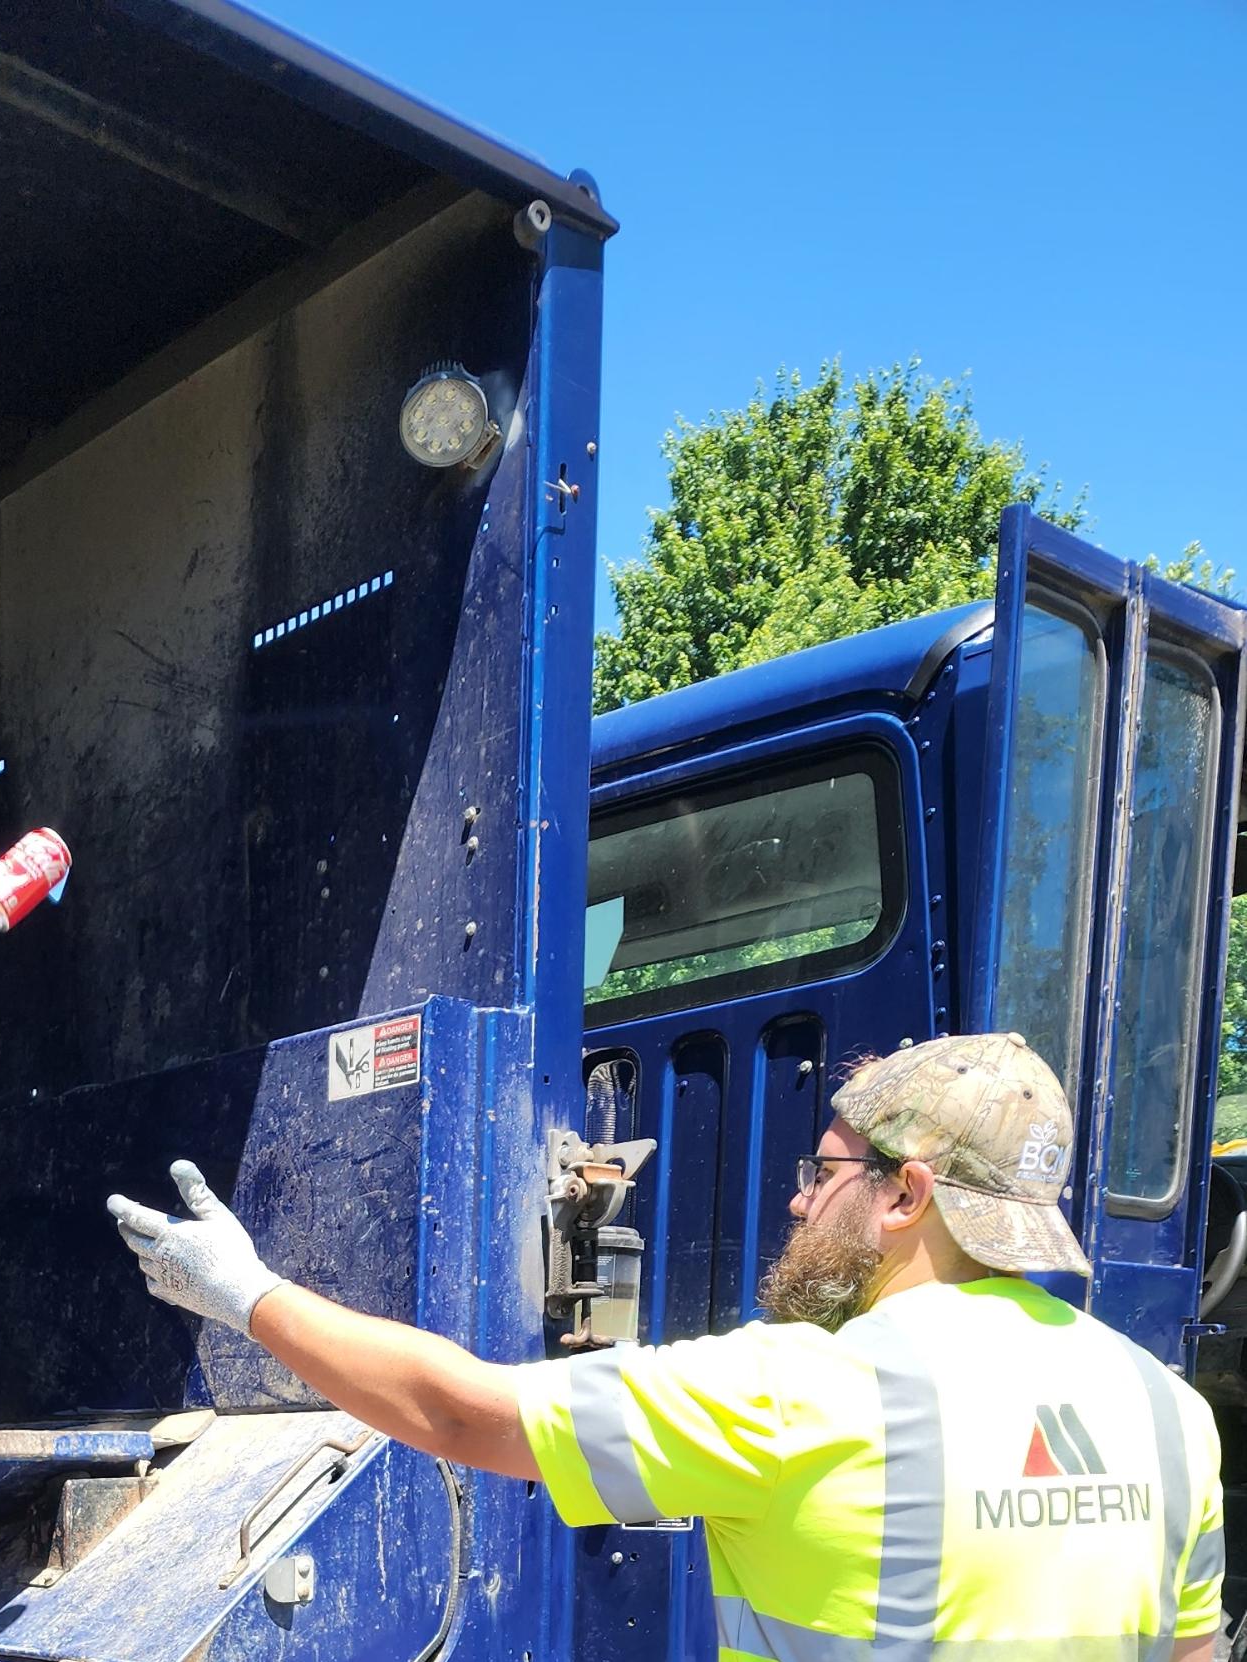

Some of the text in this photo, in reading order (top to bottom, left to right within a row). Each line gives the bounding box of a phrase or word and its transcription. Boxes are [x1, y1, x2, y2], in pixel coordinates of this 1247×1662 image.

[386, 1021, 414, 1034] DANGER
[386, 1052, 413, 1066] DANGER
[975, 1483, 1151, 1530] MODERN
